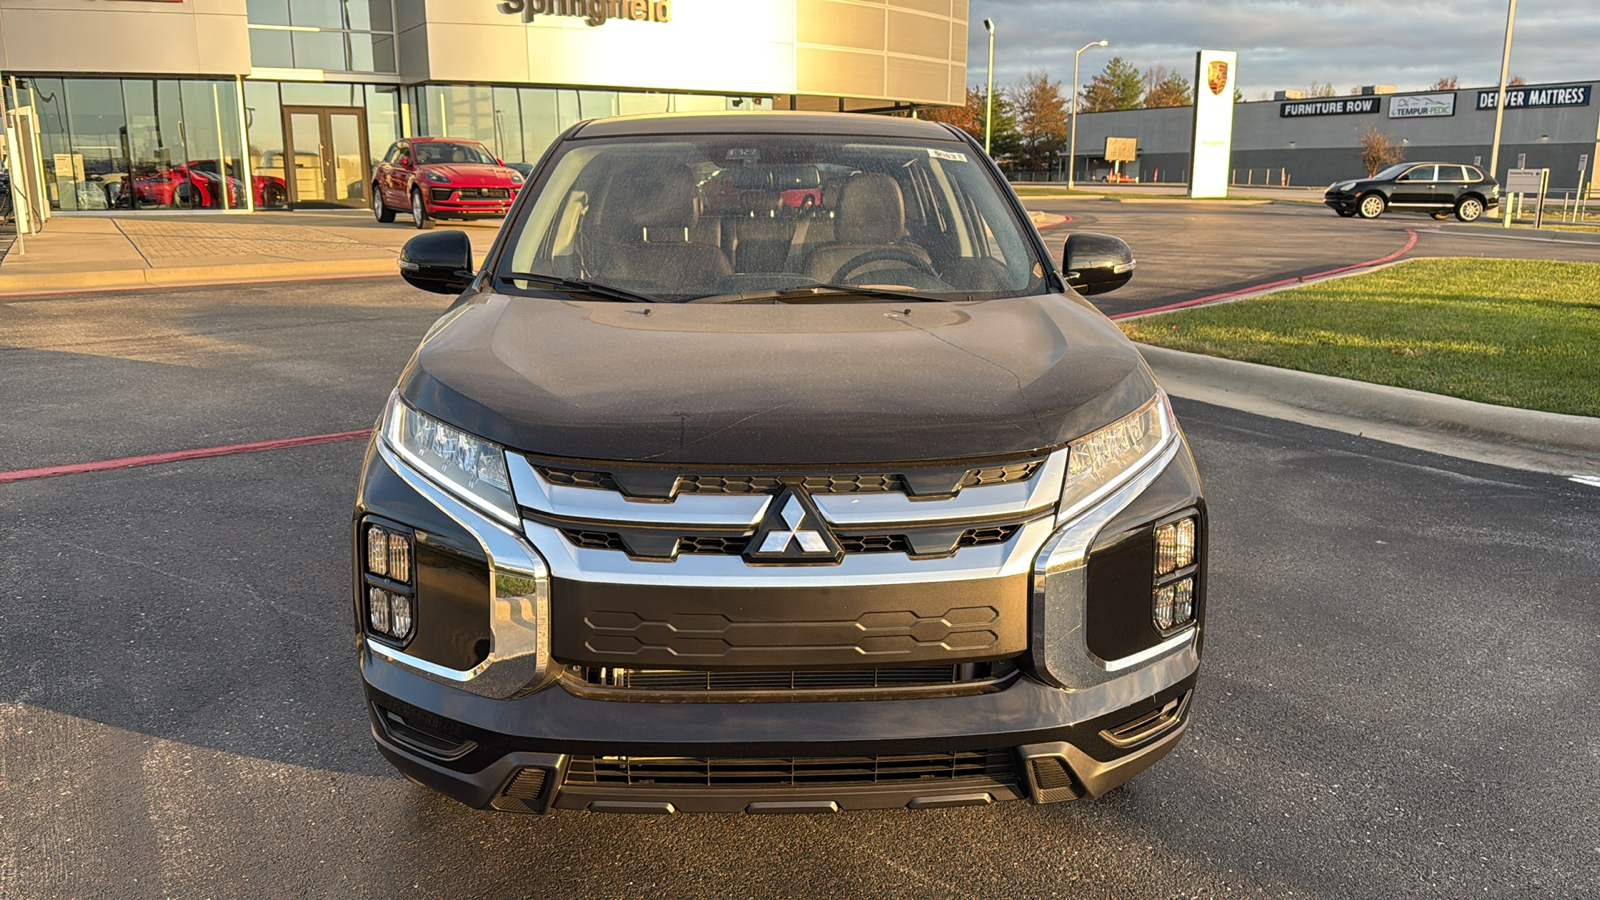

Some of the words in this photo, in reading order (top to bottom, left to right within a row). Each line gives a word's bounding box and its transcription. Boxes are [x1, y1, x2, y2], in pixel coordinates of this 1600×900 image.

[1528, 88, 1585, 105] MATTRESS
[1284, 102, 1344, 116] FURNITURE
[1346, 100, 1373, 112] ROW
[1397, 106, 1450, 115] TEMPUR-PEDIC
